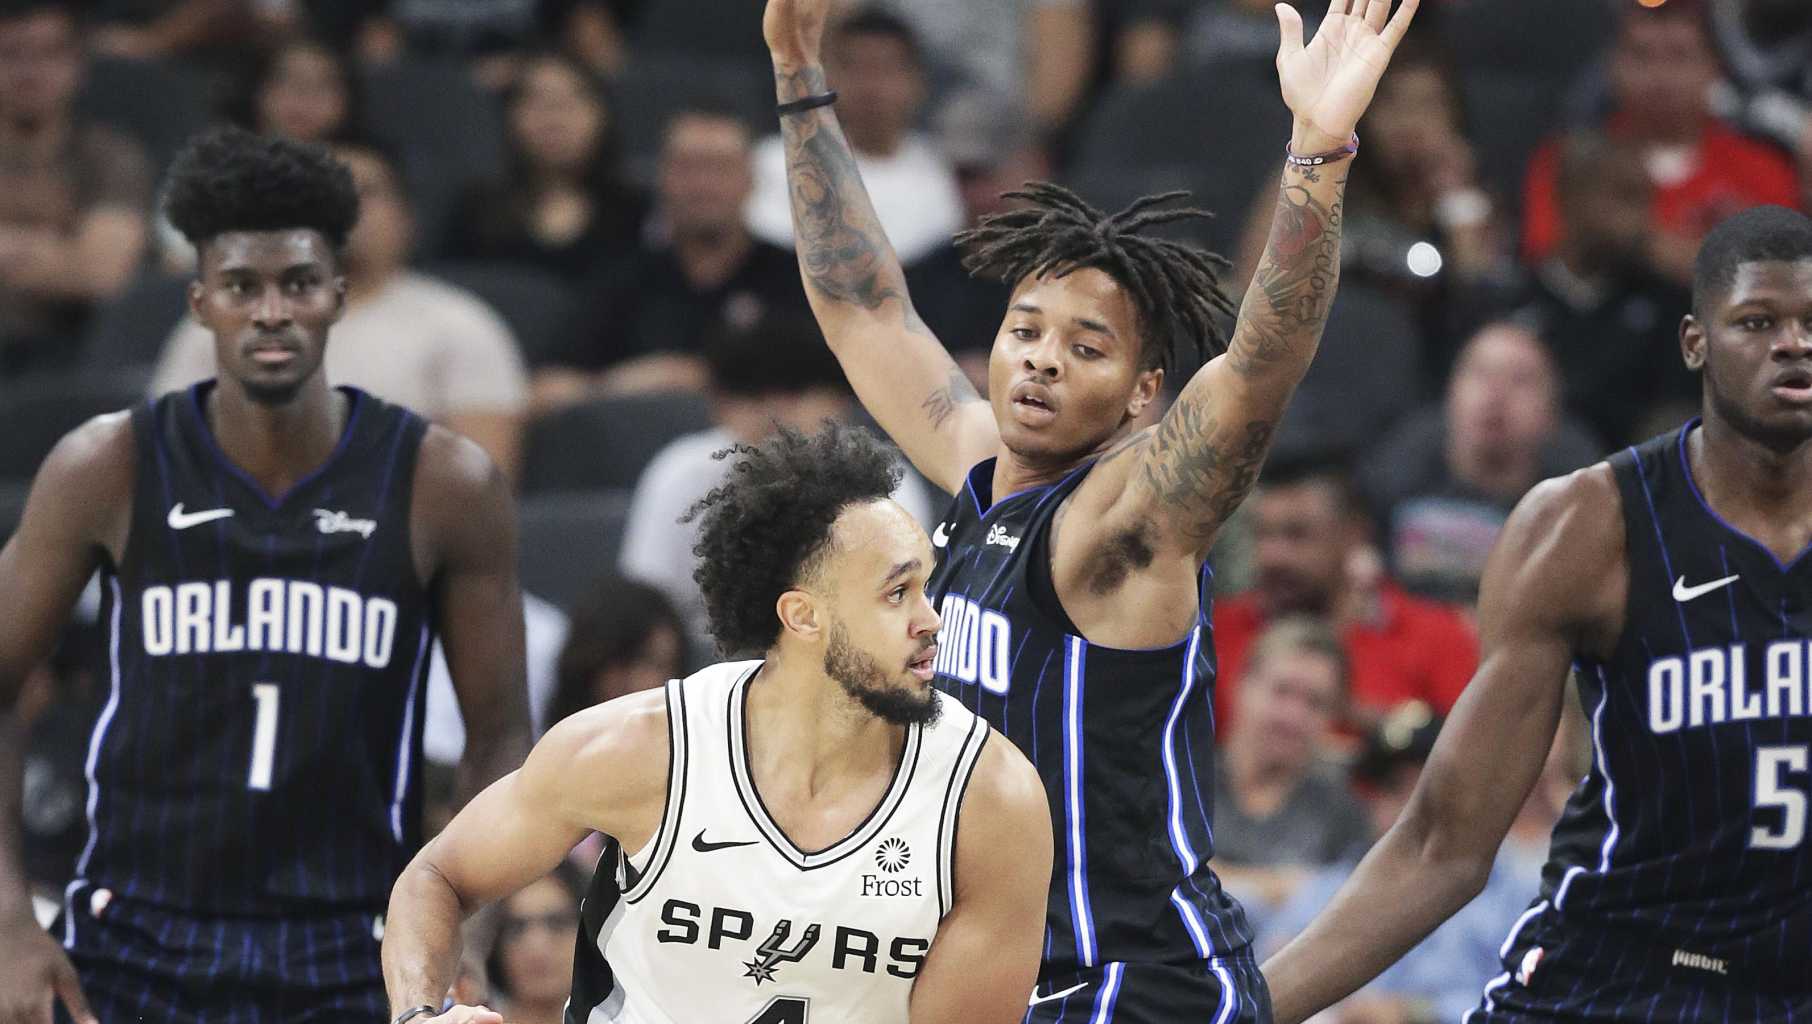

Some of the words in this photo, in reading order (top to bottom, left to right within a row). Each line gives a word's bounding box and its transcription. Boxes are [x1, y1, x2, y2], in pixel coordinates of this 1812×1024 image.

[986, 524, 1021, 554] Disney
[141, 577, 398, 669] ORLANDO
[931, 593, 1012, 696] ANDO
[1648, 640, 1812, 734] ORLA
[249, 683, 280, 790] 1
[1749, 745, 1809, 849] 5
[860, 874, 923, 897] Frost
[656, 898, 930, 986] SPURS
